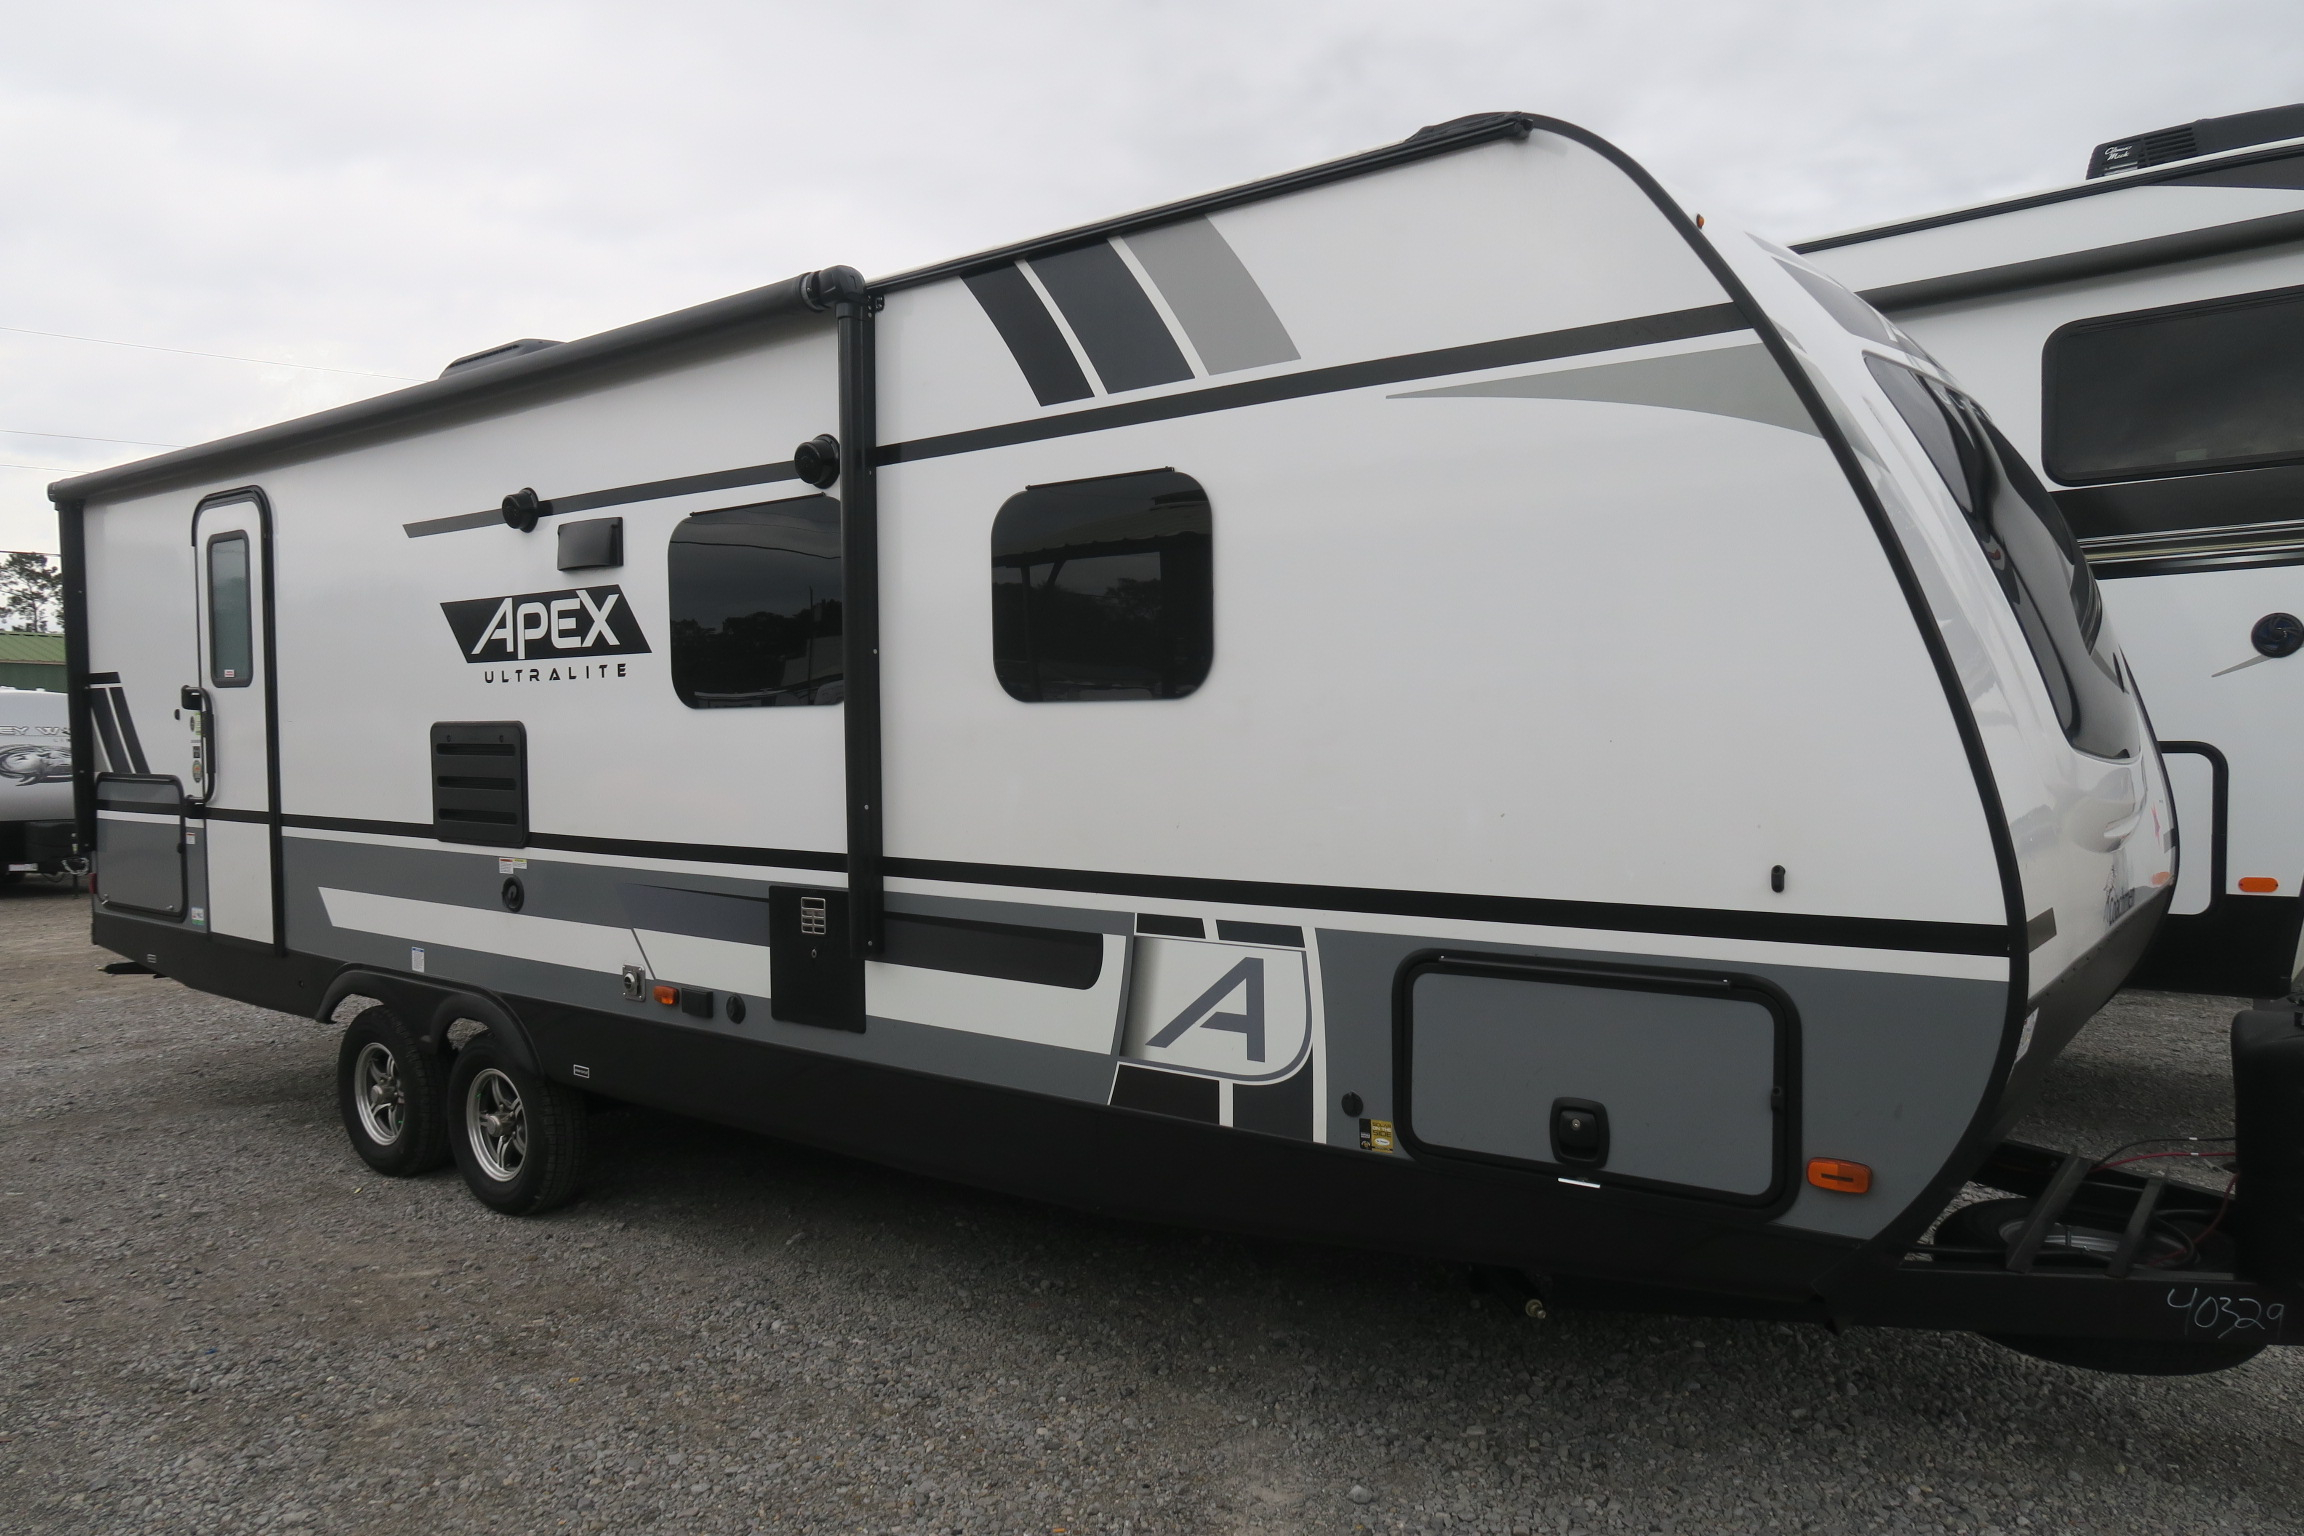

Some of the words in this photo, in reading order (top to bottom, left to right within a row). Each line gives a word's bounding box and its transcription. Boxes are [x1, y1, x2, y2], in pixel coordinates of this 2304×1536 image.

[470, 589, 621, 660] APEX
[484, 663, 627, 684] ULTRALITE
[1144, 956, 1266, 1063] A
[1372, 1130, 1392, 1138] SIDE
[2166, 1287, 2285, 1339] 40329
